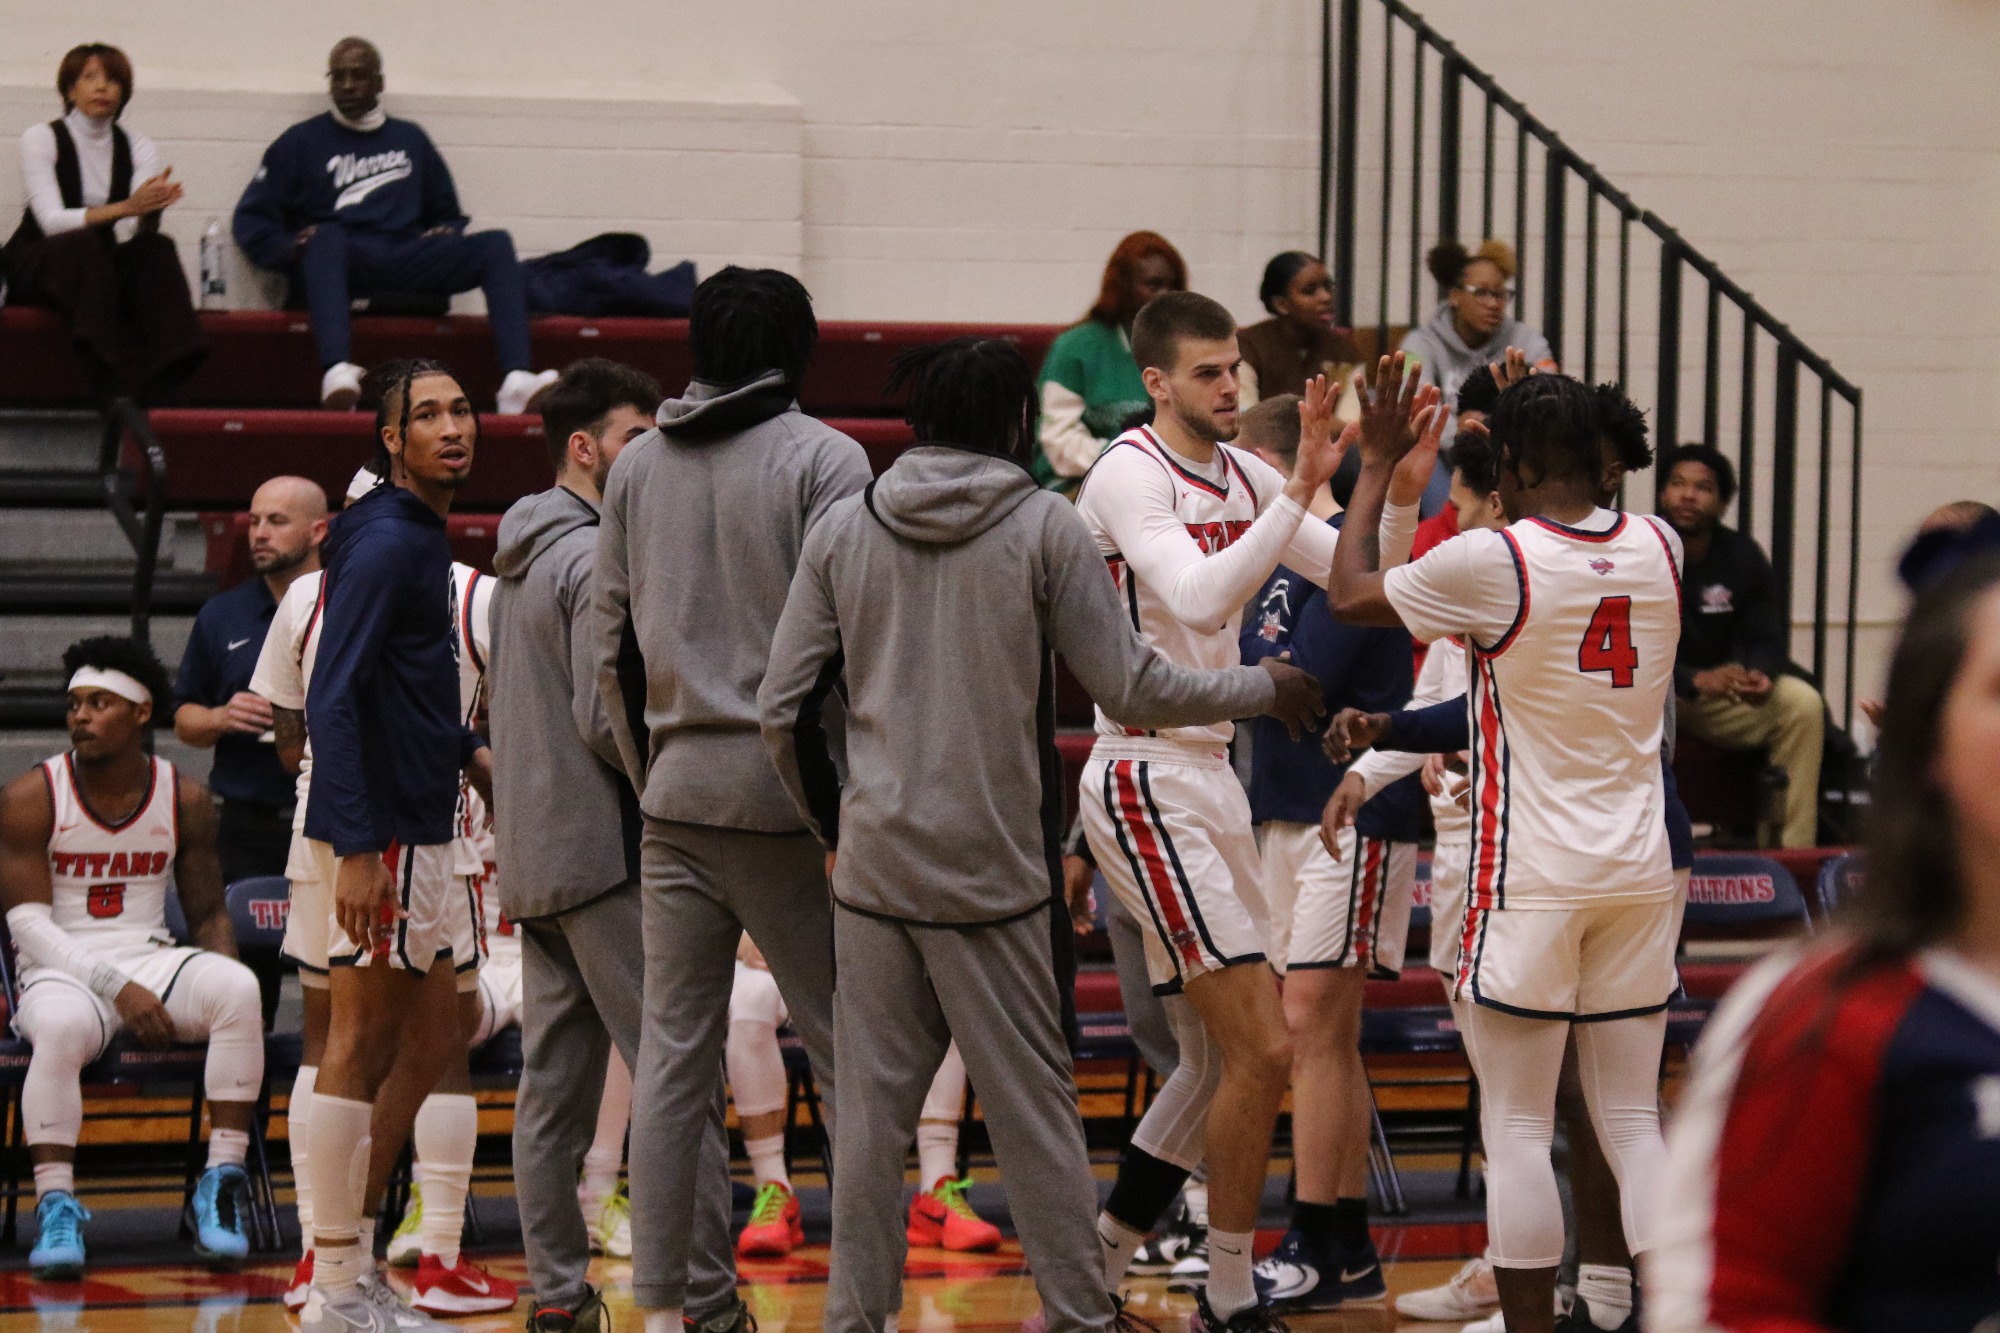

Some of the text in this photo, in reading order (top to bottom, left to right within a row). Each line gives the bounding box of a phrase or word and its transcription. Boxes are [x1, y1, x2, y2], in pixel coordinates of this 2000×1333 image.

[326, 150, 411, 189] Warren
[1578, 595, 1638, 688] 4
[51, 851, 169, 877] TITANS
[1688, 873, 1775, 904] TITANS
